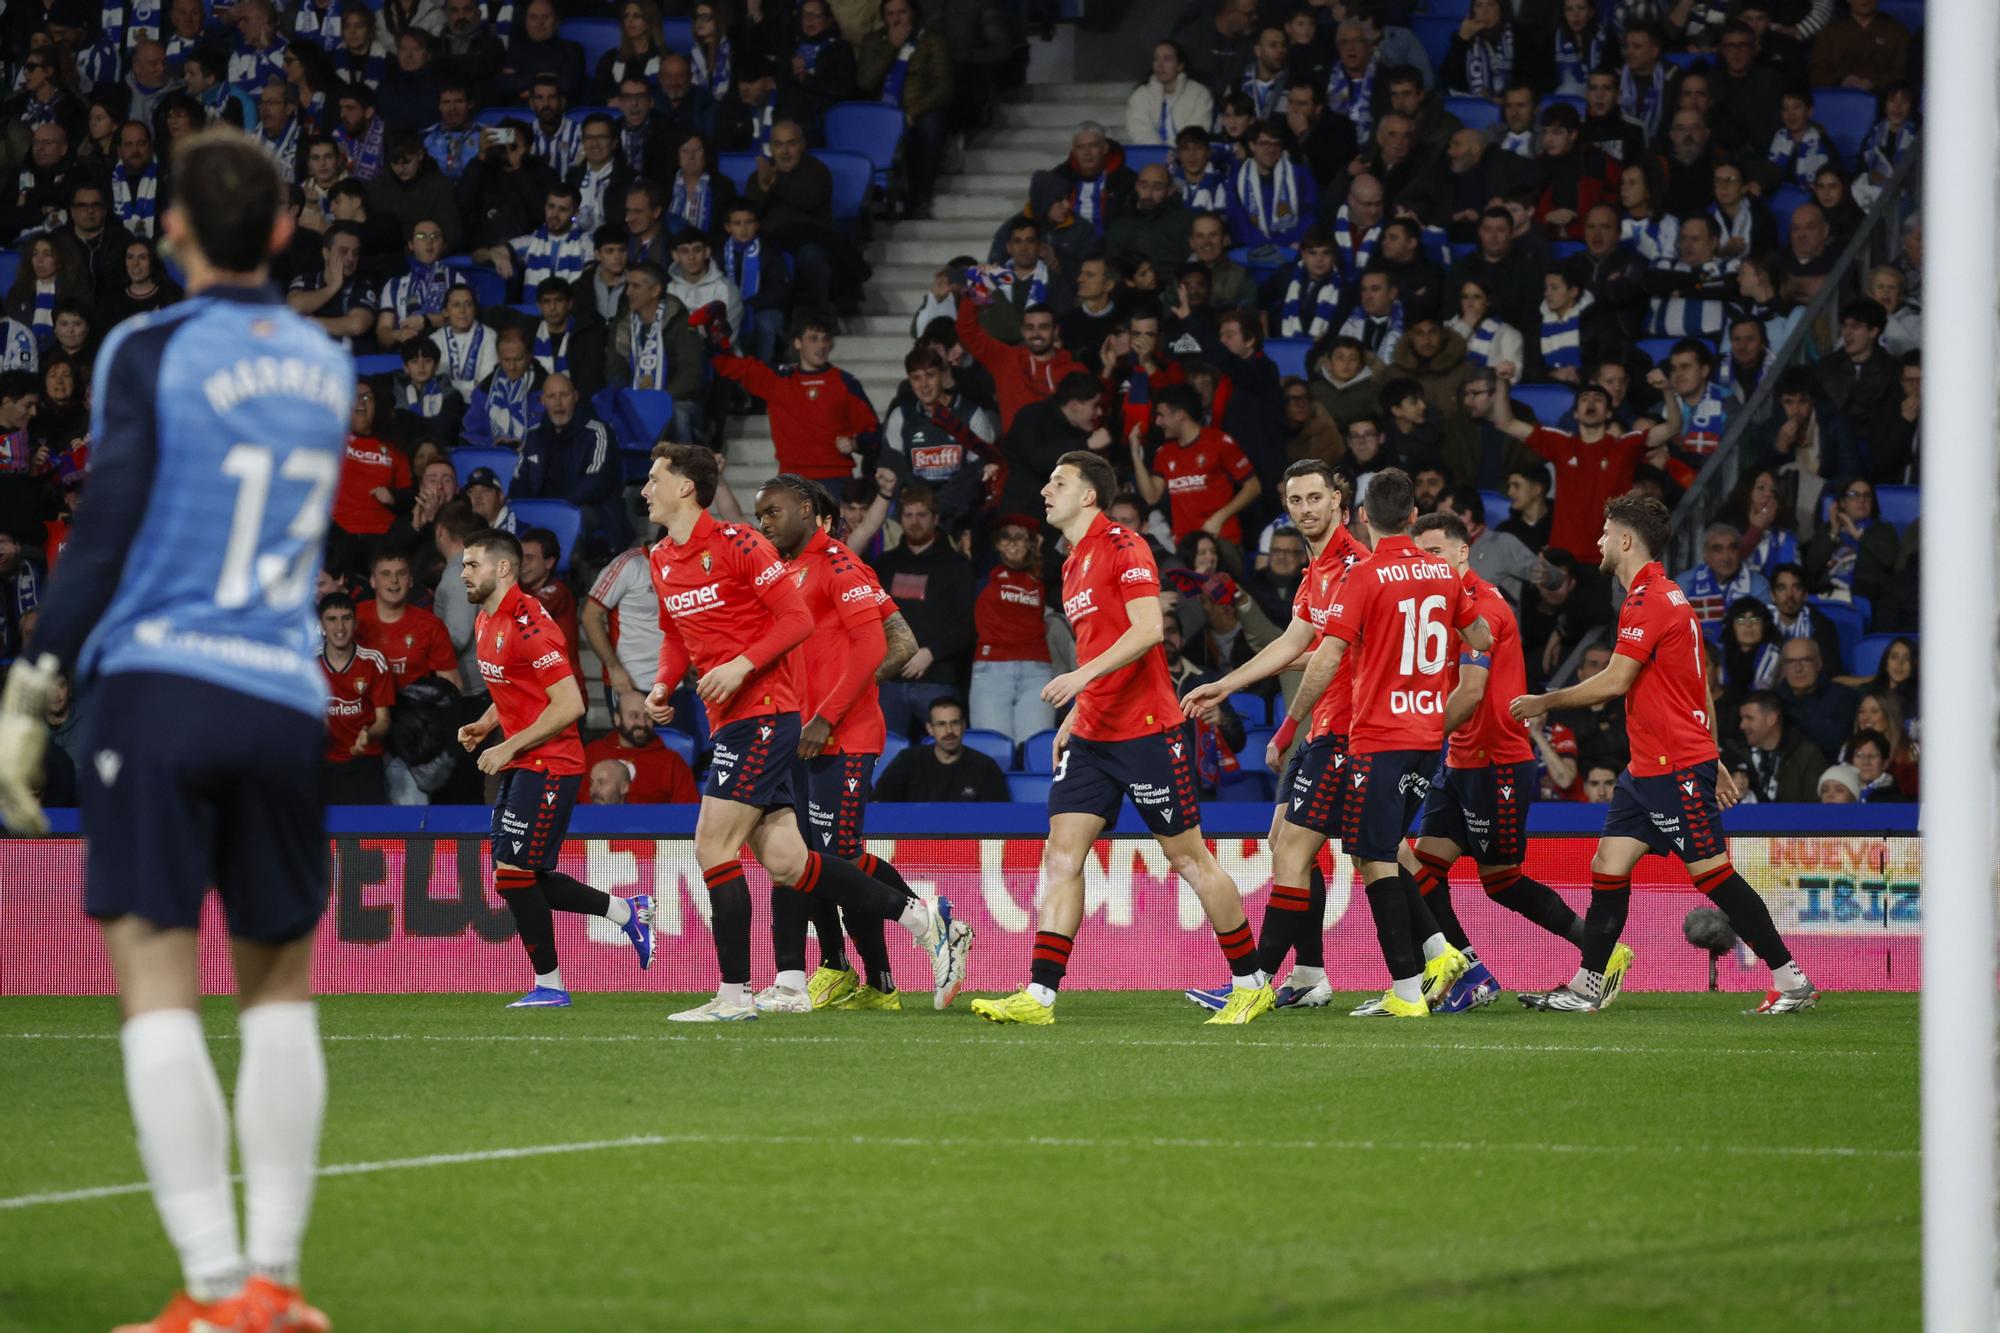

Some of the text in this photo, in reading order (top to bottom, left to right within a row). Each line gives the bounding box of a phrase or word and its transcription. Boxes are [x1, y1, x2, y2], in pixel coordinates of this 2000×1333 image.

[219, 443, 338, 610] 13
[1376, 564, 1409, 584] MOI
[1398, 594, 1448, 676] 16
[1390, 691, 1444, 715] DIGI
[1768, 838, 1889, 872] NUEVO
